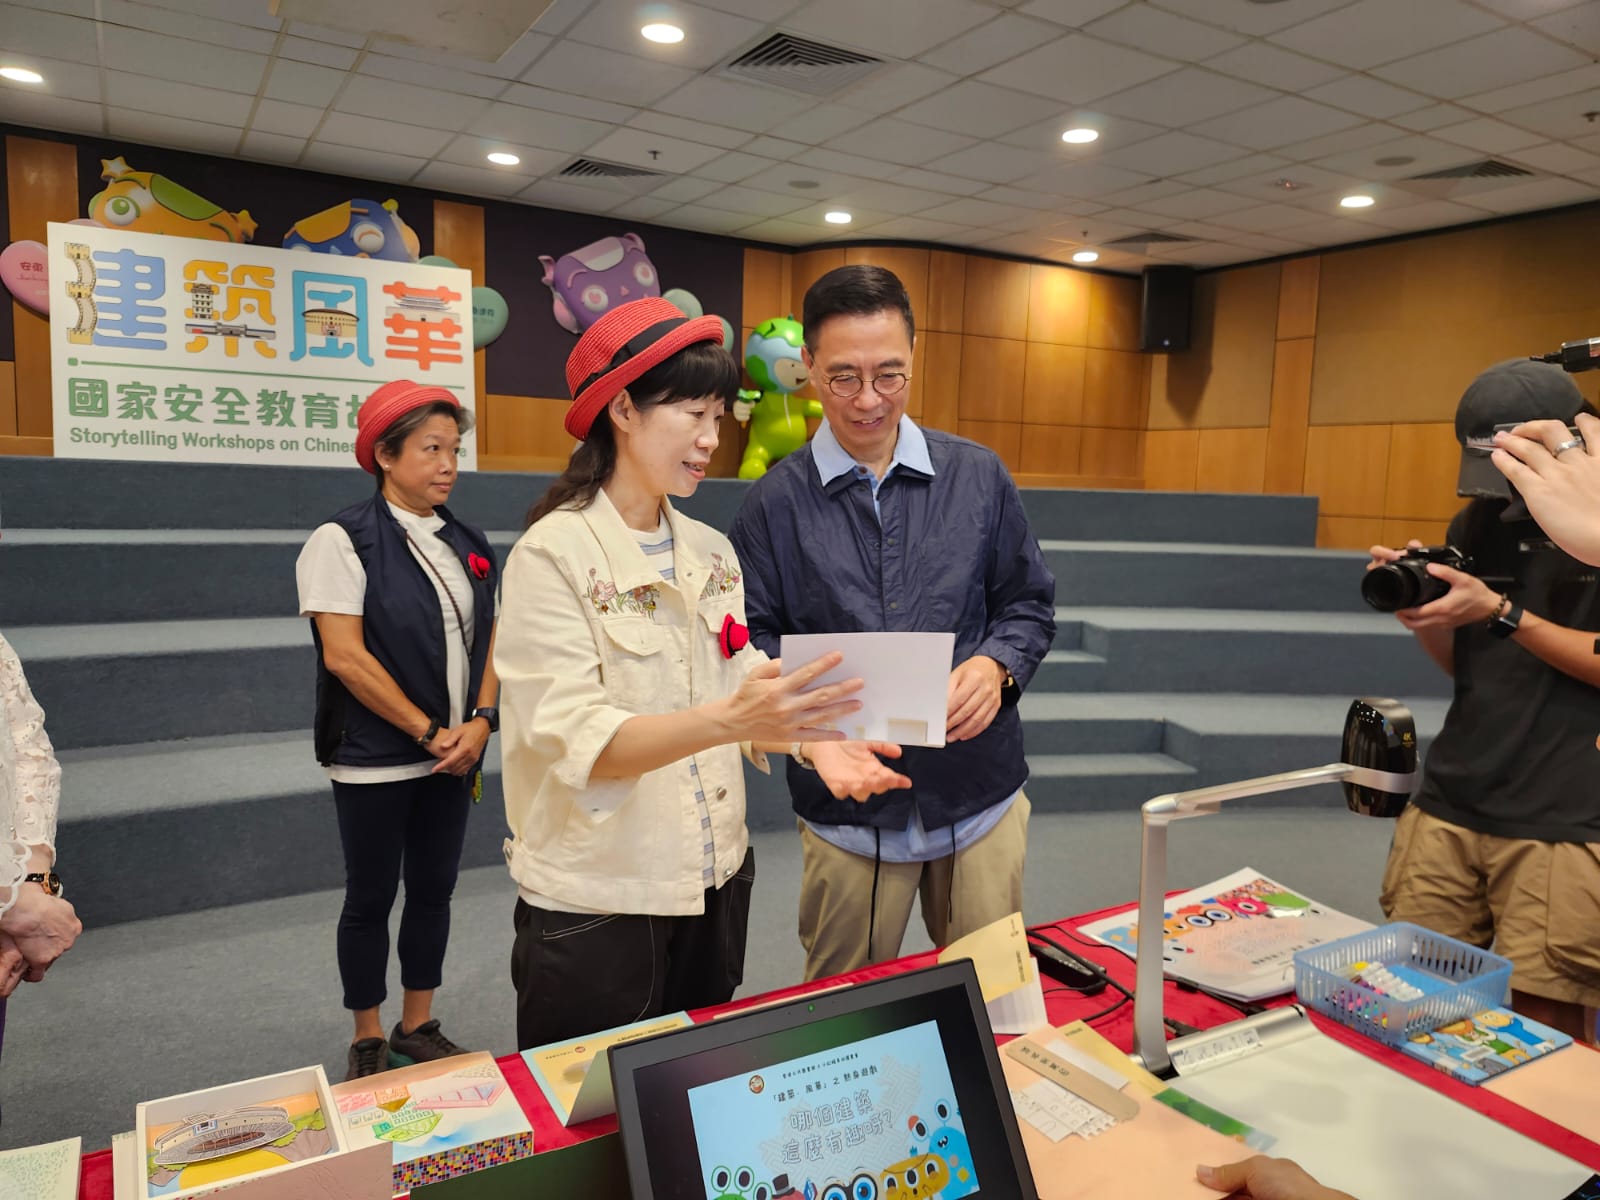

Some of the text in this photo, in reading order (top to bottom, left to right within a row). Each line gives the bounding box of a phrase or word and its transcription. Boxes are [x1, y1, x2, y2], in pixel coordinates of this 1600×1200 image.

[64, 241, 463, 372] 建築風華
[69, 427, 356, 453] Storytelling Workshops on Chines
[790, 1088, 874, 1132] 哪個建築
